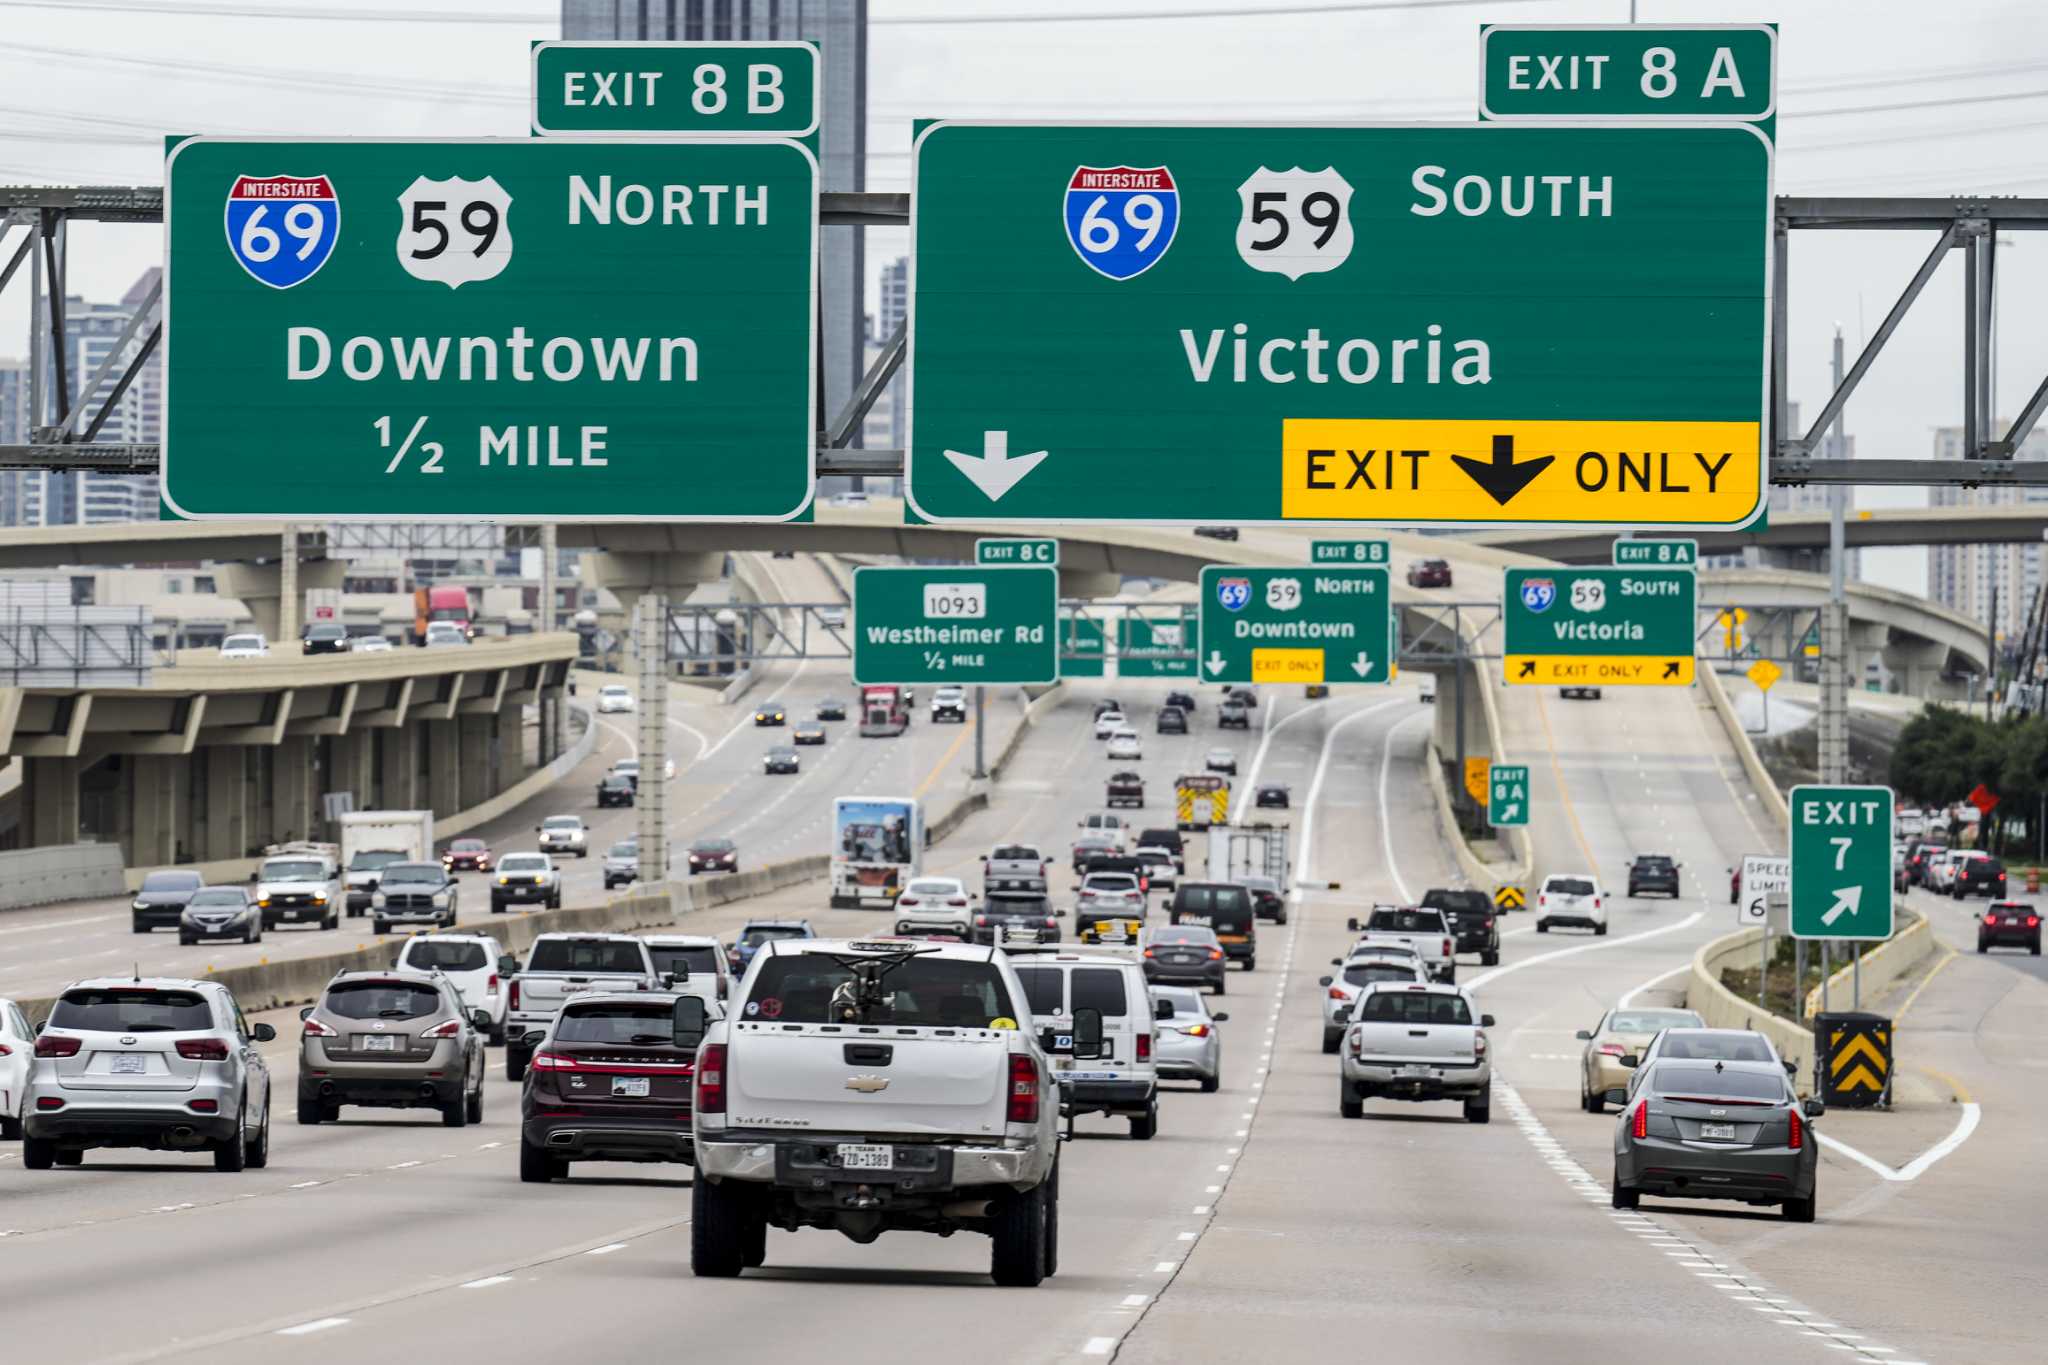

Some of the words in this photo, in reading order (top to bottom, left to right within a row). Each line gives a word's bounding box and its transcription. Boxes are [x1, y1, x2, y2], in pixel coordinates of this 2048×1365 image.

[1509, 56, 1609, 89] EXIT
[565, 73, 662, 105] EXIT
[243, 183, 321, 196] INTERSTATE
[1082, 173, 1161, 188] INTERSTATE
[240, 204, 325, 263] 69
[411, 201, 498, 259] 59
[1079, 195, 1164, 254] 69
[1251, 192, 1340, 250] 59
[288, 327, 697, 381] Downtown
[1180, 323, 1491, 384] Victoria
[480, 426, 607, 465] MILE
[1307, 450, 1429, 489] EXIT
[1576, 452, 1732, 492] ONLY
[984, 546, 1013, 559] EXIT
[1317, 545, 1347, 559] EXIT
[1620, 546, 1651, 560] EXIT
[1220, 587, 1248, 605] 69
[1270, 584, 1297, 603] 59
[1524, 588, 1552, 606] 69
[1575, 586, 1602, 604] 59
[931, 596, 979, 615] 1093
[867, 625, 1003, 644] Westheimer
[1015, 625, 1044, 644] Rd
[1234, 619, 1355, 638] Downtown
[1553, 620, 1644, 640] Victoria
[952, 654, 985, 667] MILE
[1254, 659, 1281, 671] EXIT
[1288, 660, 1319, 672] ONLY
[1553, 664, 1588, 677] EXIT
[1598, 664, 1642, 677] ONLY
[1493, 769, 1524, 782] EXIT
[1804, 802, 1879, 824] EXIT
[1830, 838, 1852, 870] 7
[1751, 882, 1787, 893] LIMIT
